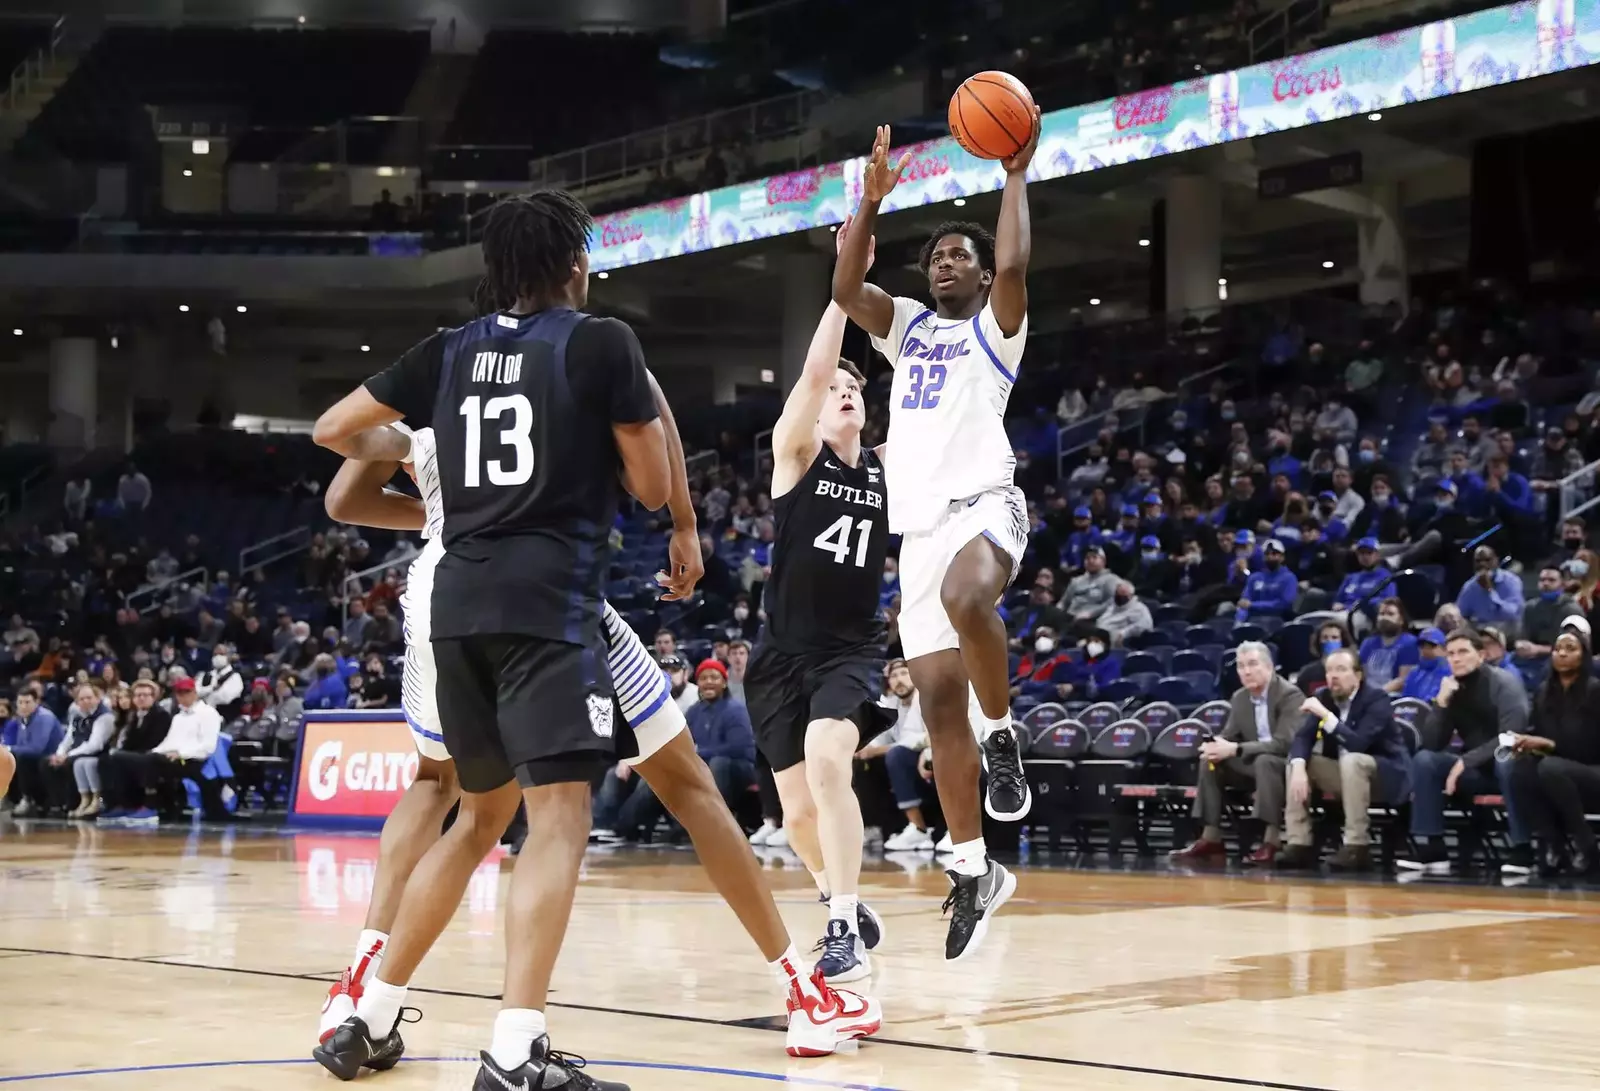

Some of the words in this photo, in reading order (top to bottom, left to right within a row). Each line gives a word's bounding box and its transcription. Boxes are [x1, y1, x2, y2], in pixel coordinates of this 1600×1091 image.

[1272, 63, 1343, 102] Coors
[472, 351, 523, 384] TAYLOR
[901, 364, 948, 410] 32
[459, 393, 534, 488] 13
[815, 479, 883, 511] BUTLER
[813, 514, 874, 568] 41
[308, 740, 343, 801] G
